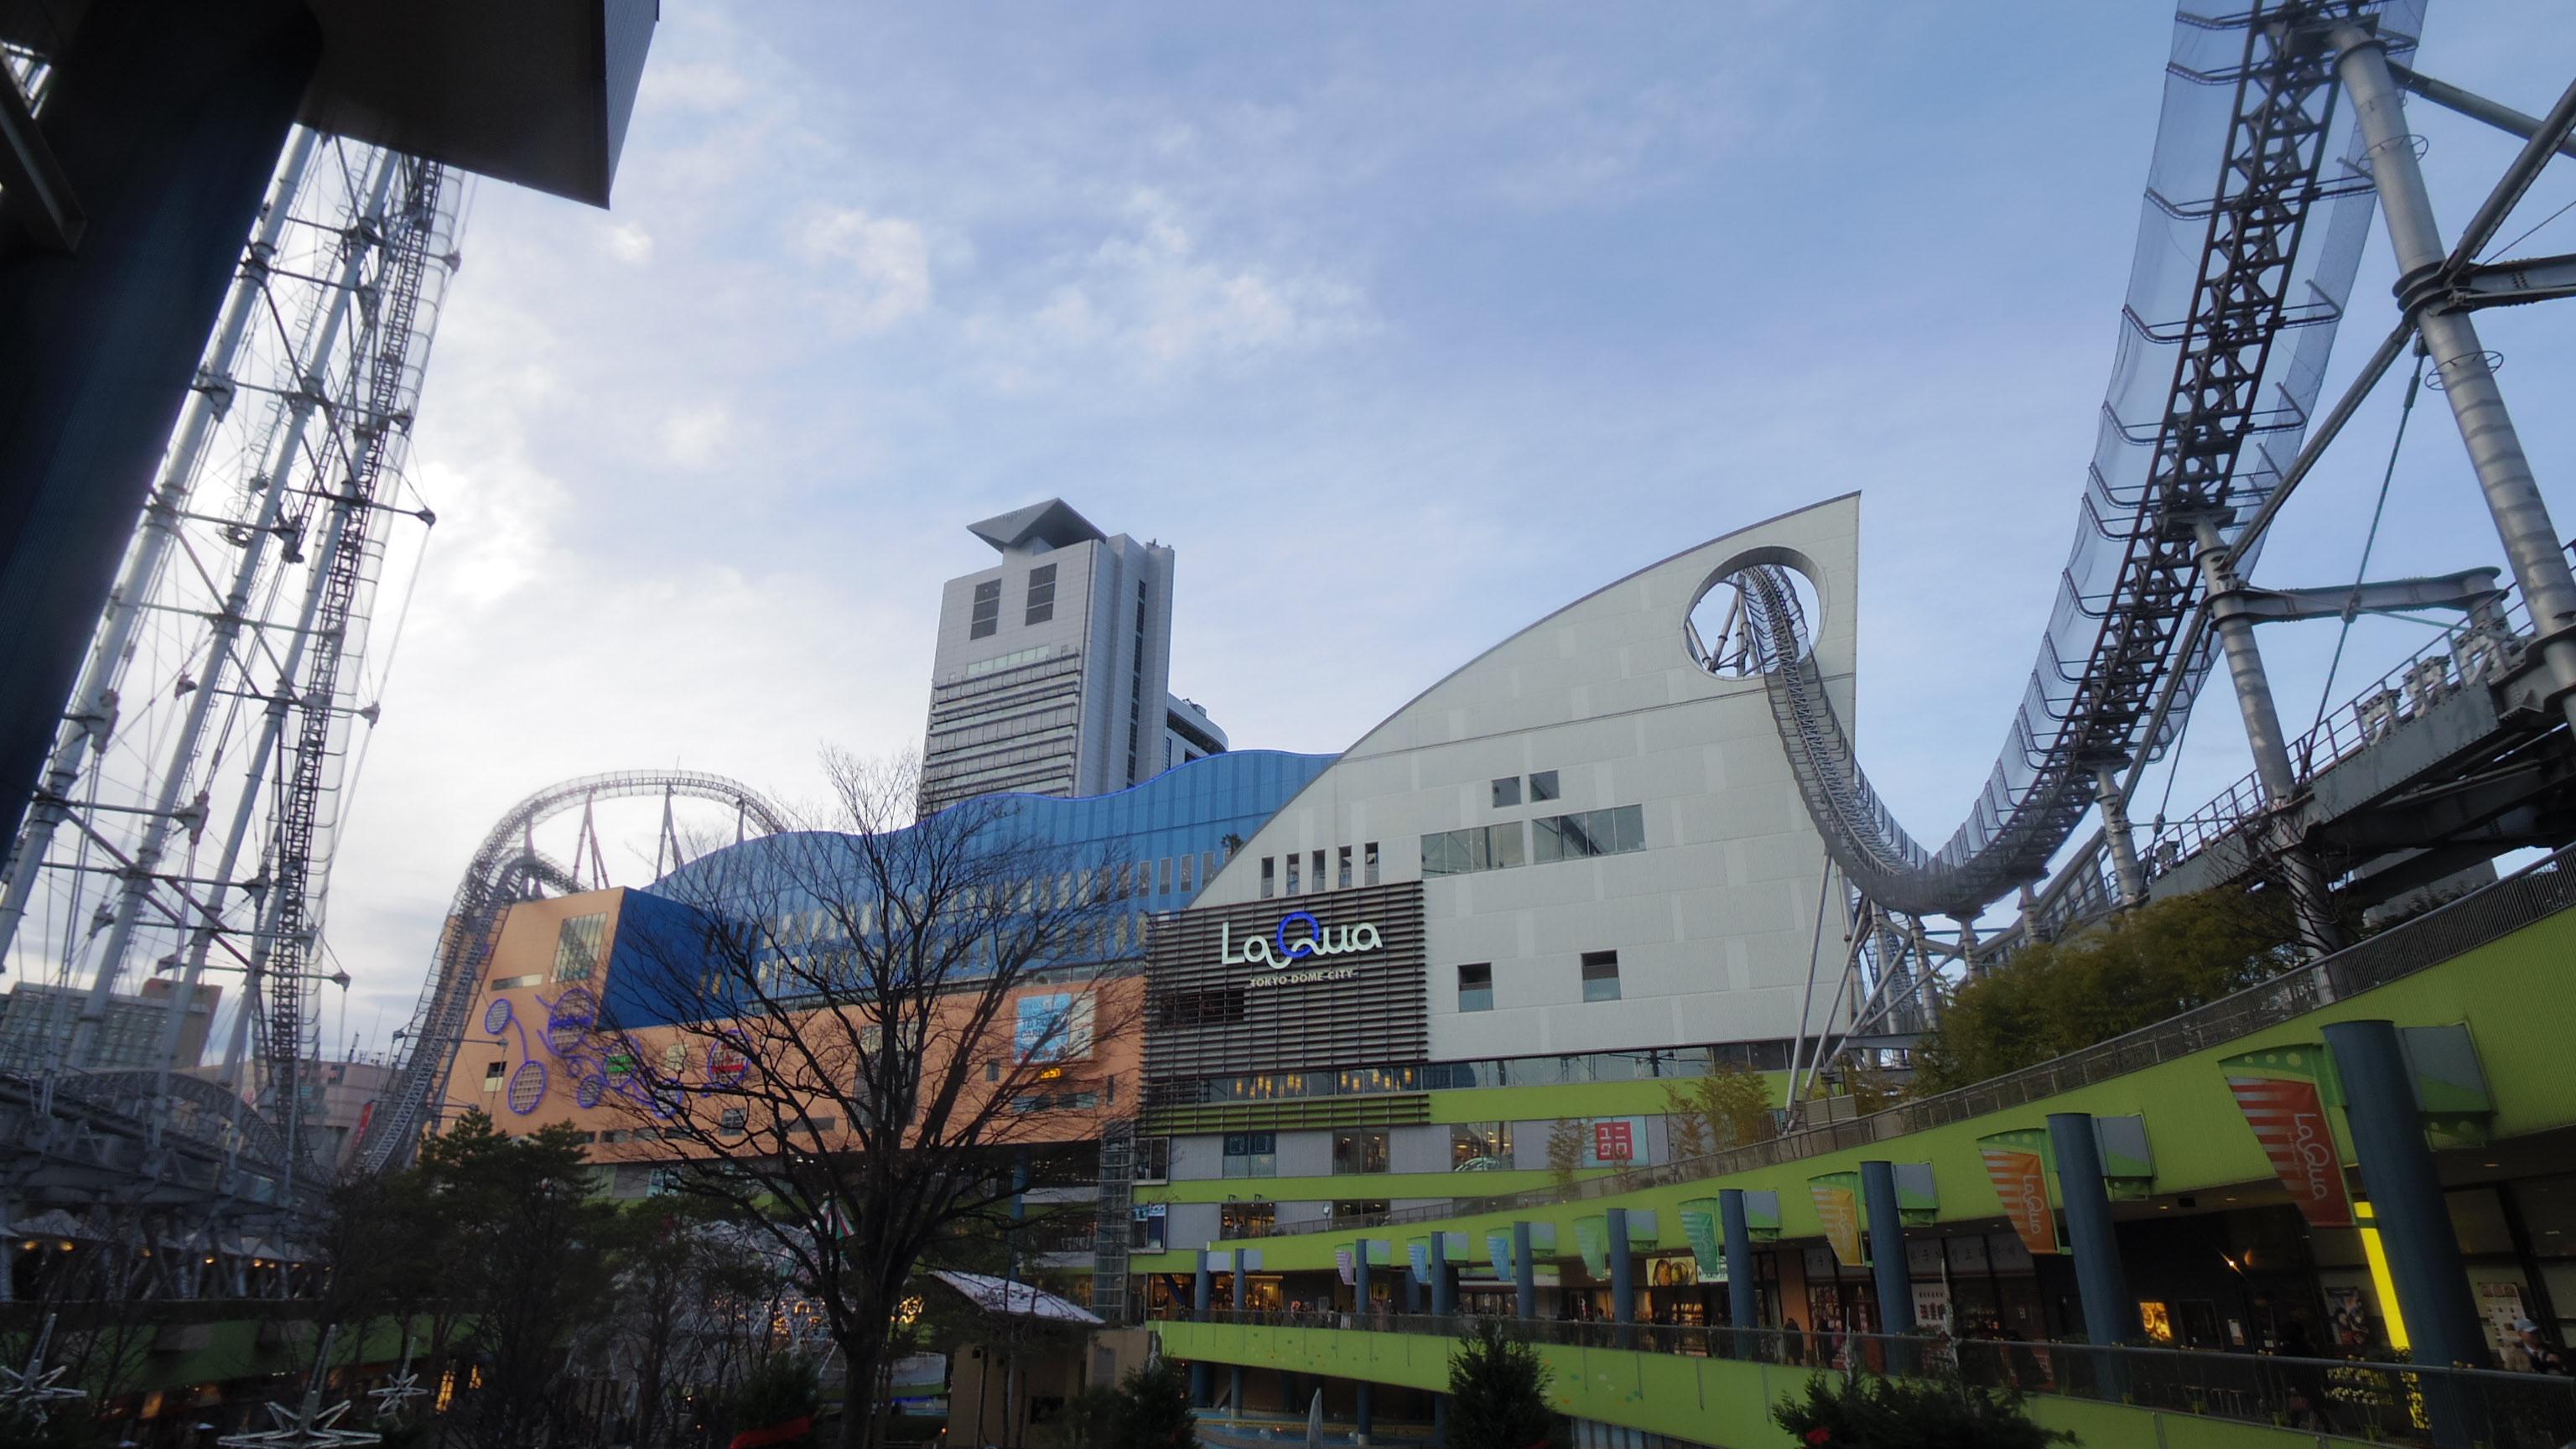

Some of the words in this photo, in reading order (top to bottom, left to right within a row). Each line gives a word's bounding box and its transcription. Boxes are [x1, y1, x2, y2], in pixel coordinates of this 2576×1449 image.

[1223, 911, 1383, 969] LaQua
[1250, 975, 1287, 987] TOKYO
[1291, 972, 1323, 984] DOME
[1327, 969, 1353, 979] CITY
[2294, 1114, 2329, 1201] LaQua
[2023, 1175, 2044, 1234] LaQua
